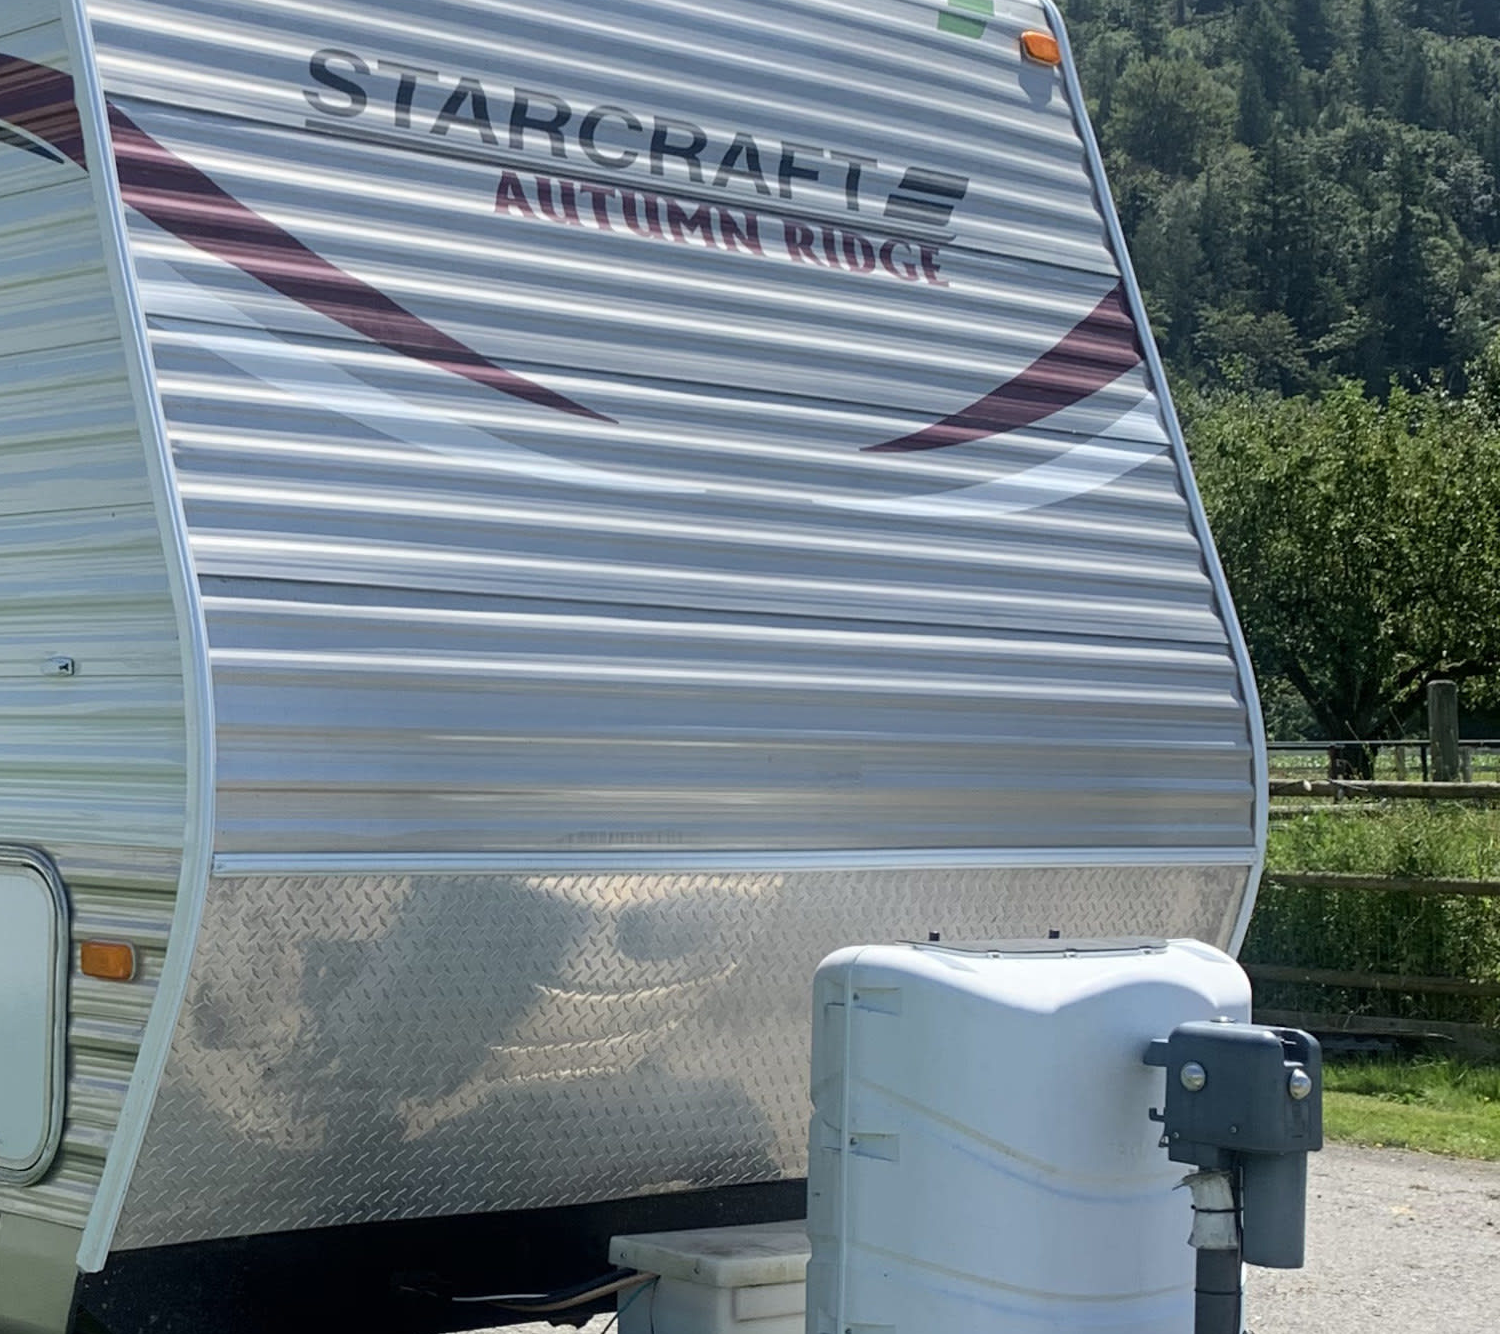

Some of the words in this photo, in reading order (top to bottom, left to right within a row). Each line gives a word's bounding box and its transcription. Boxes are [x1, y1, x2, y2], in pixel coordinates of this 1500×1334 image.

[301, 48, 878, 212] STARCRAFT
[493, 170, 767, 257] AUTUMN
[782, 218, 950, 288] RIDGE
